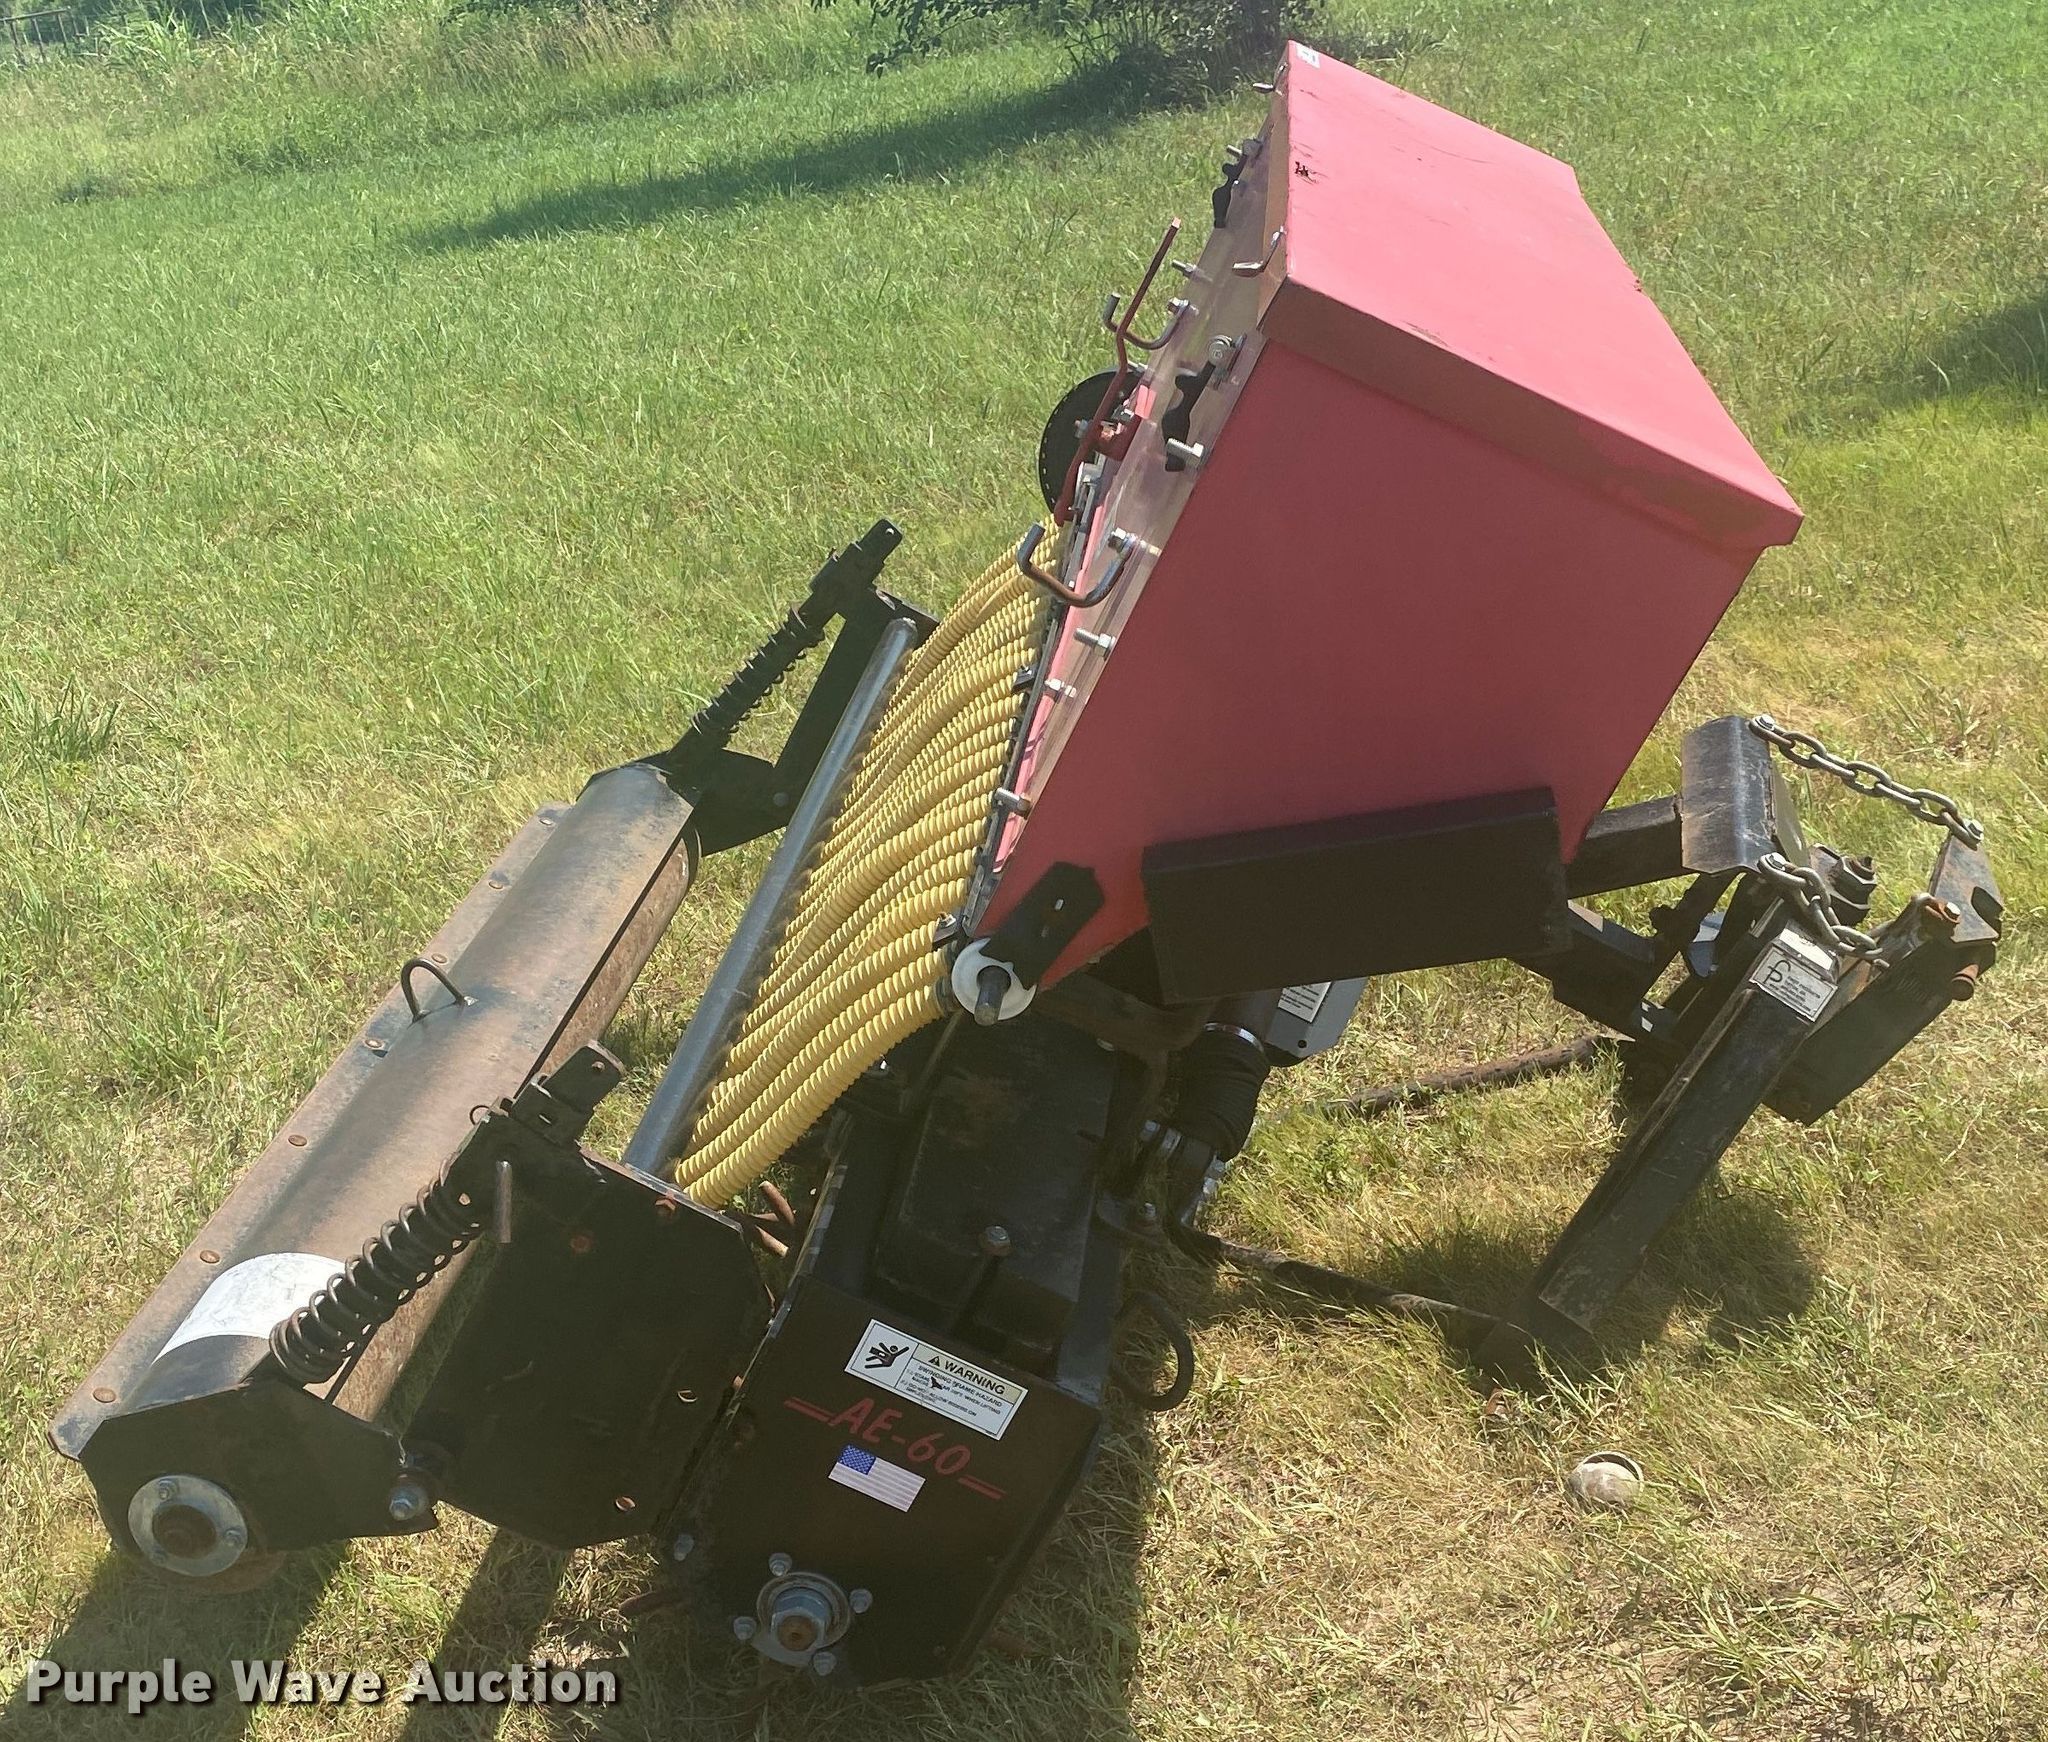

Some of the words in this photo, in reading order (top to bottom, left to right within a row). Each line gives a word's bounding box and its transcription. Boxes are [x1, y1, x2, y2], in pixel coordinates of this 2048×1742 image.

[944, 1361, 1005, 1394] WARNING
[976, 1392, 1002, 1406] HAZARD
[828, 1397, 971, 1475] AE-60
